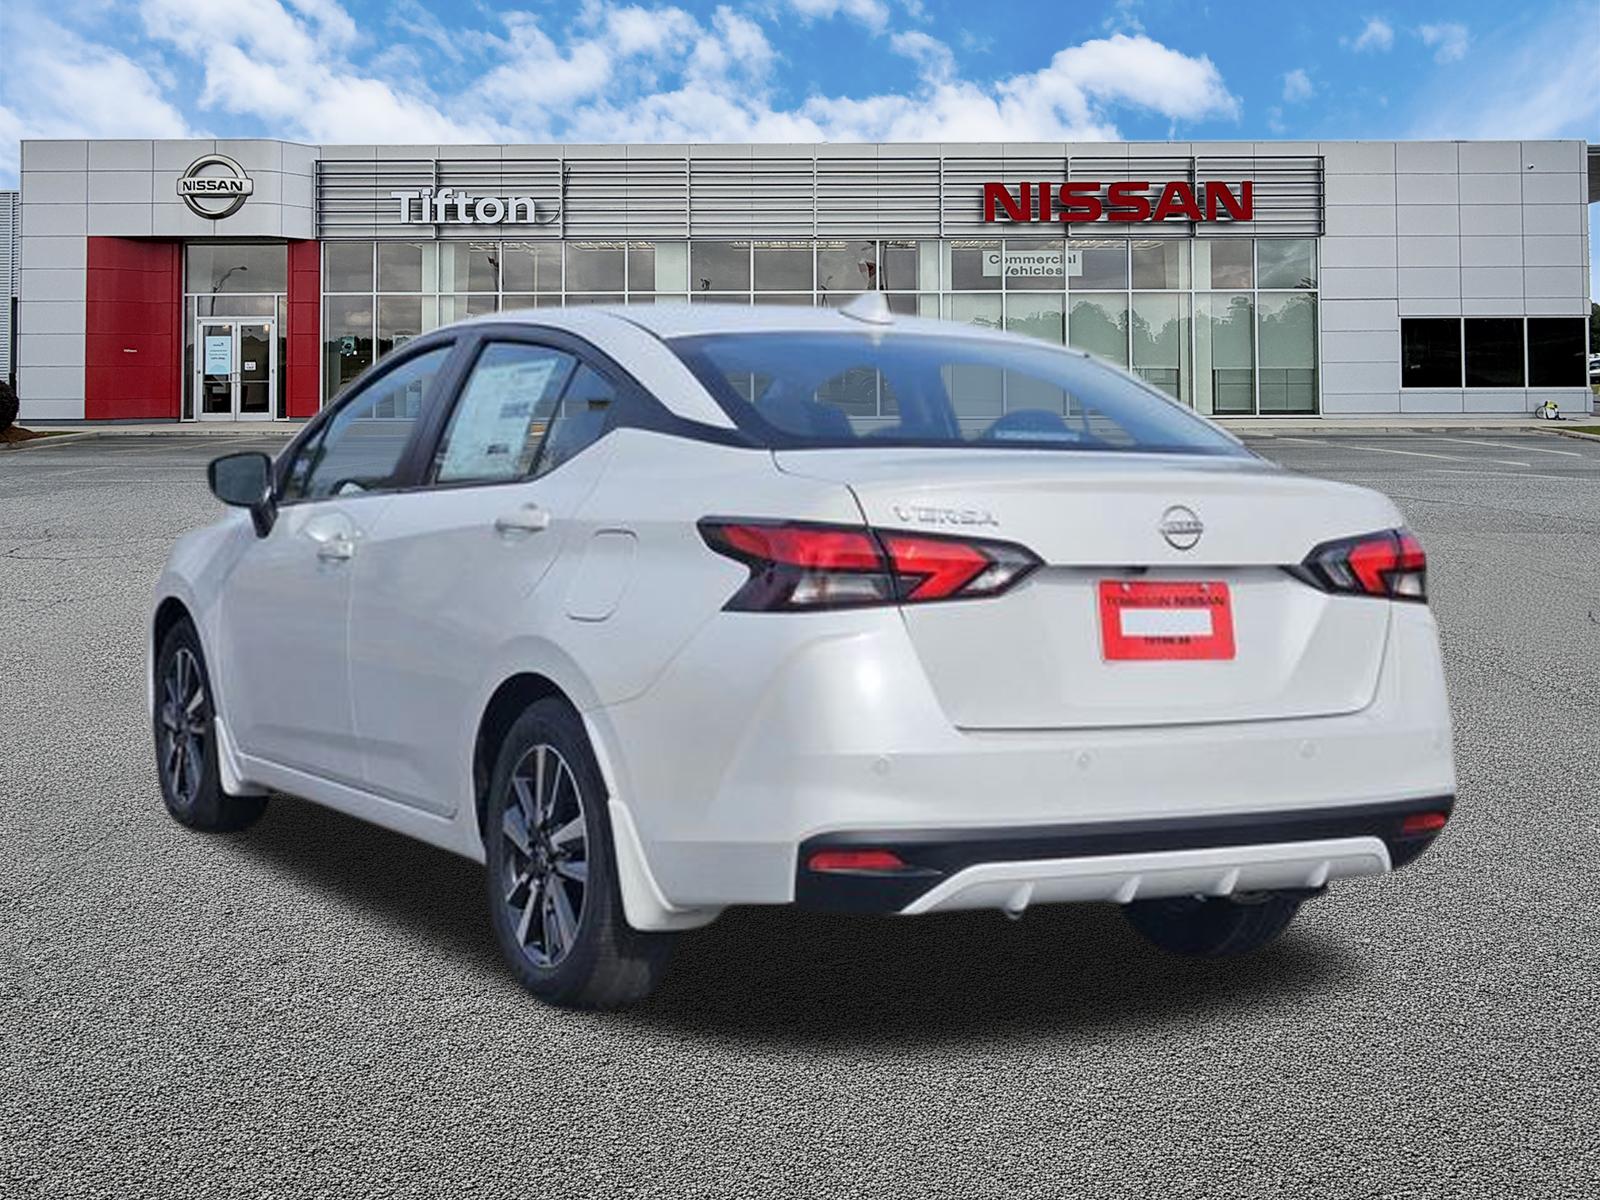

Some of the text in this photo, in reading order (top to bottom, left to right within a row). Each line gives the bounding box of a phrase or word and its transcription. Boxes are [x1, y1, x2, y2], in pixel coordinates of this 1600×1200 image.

[182, 180, 243, 191] NISSAN
[983, 181, 1253, 222] NISSAN
[391, 188, 536, 224] Tifton
